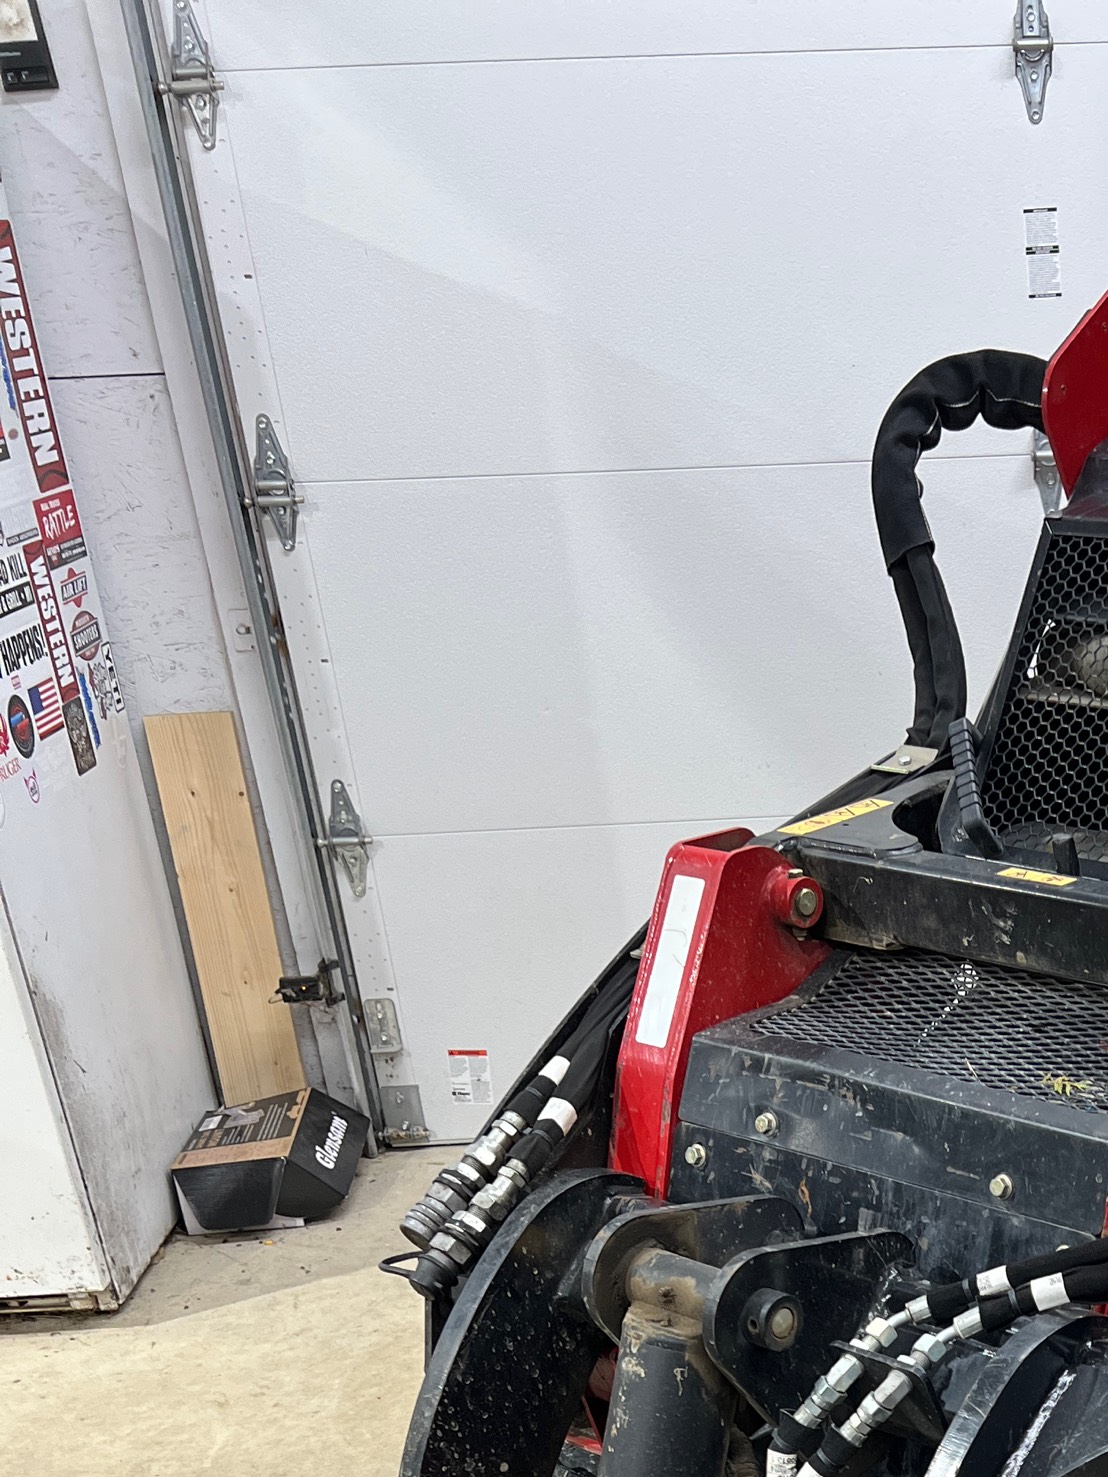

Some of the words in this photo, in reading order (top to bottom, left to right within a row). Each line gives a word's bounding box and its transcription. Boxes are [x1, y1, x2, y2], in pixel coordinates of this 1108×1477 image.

[0, 246, 59, 466] WESTERN
[42, 505, 75, 540] RATTLE
[0, 623, 48, 676] HAPPENS!
[30, 555, 74, 687] WESTERN
